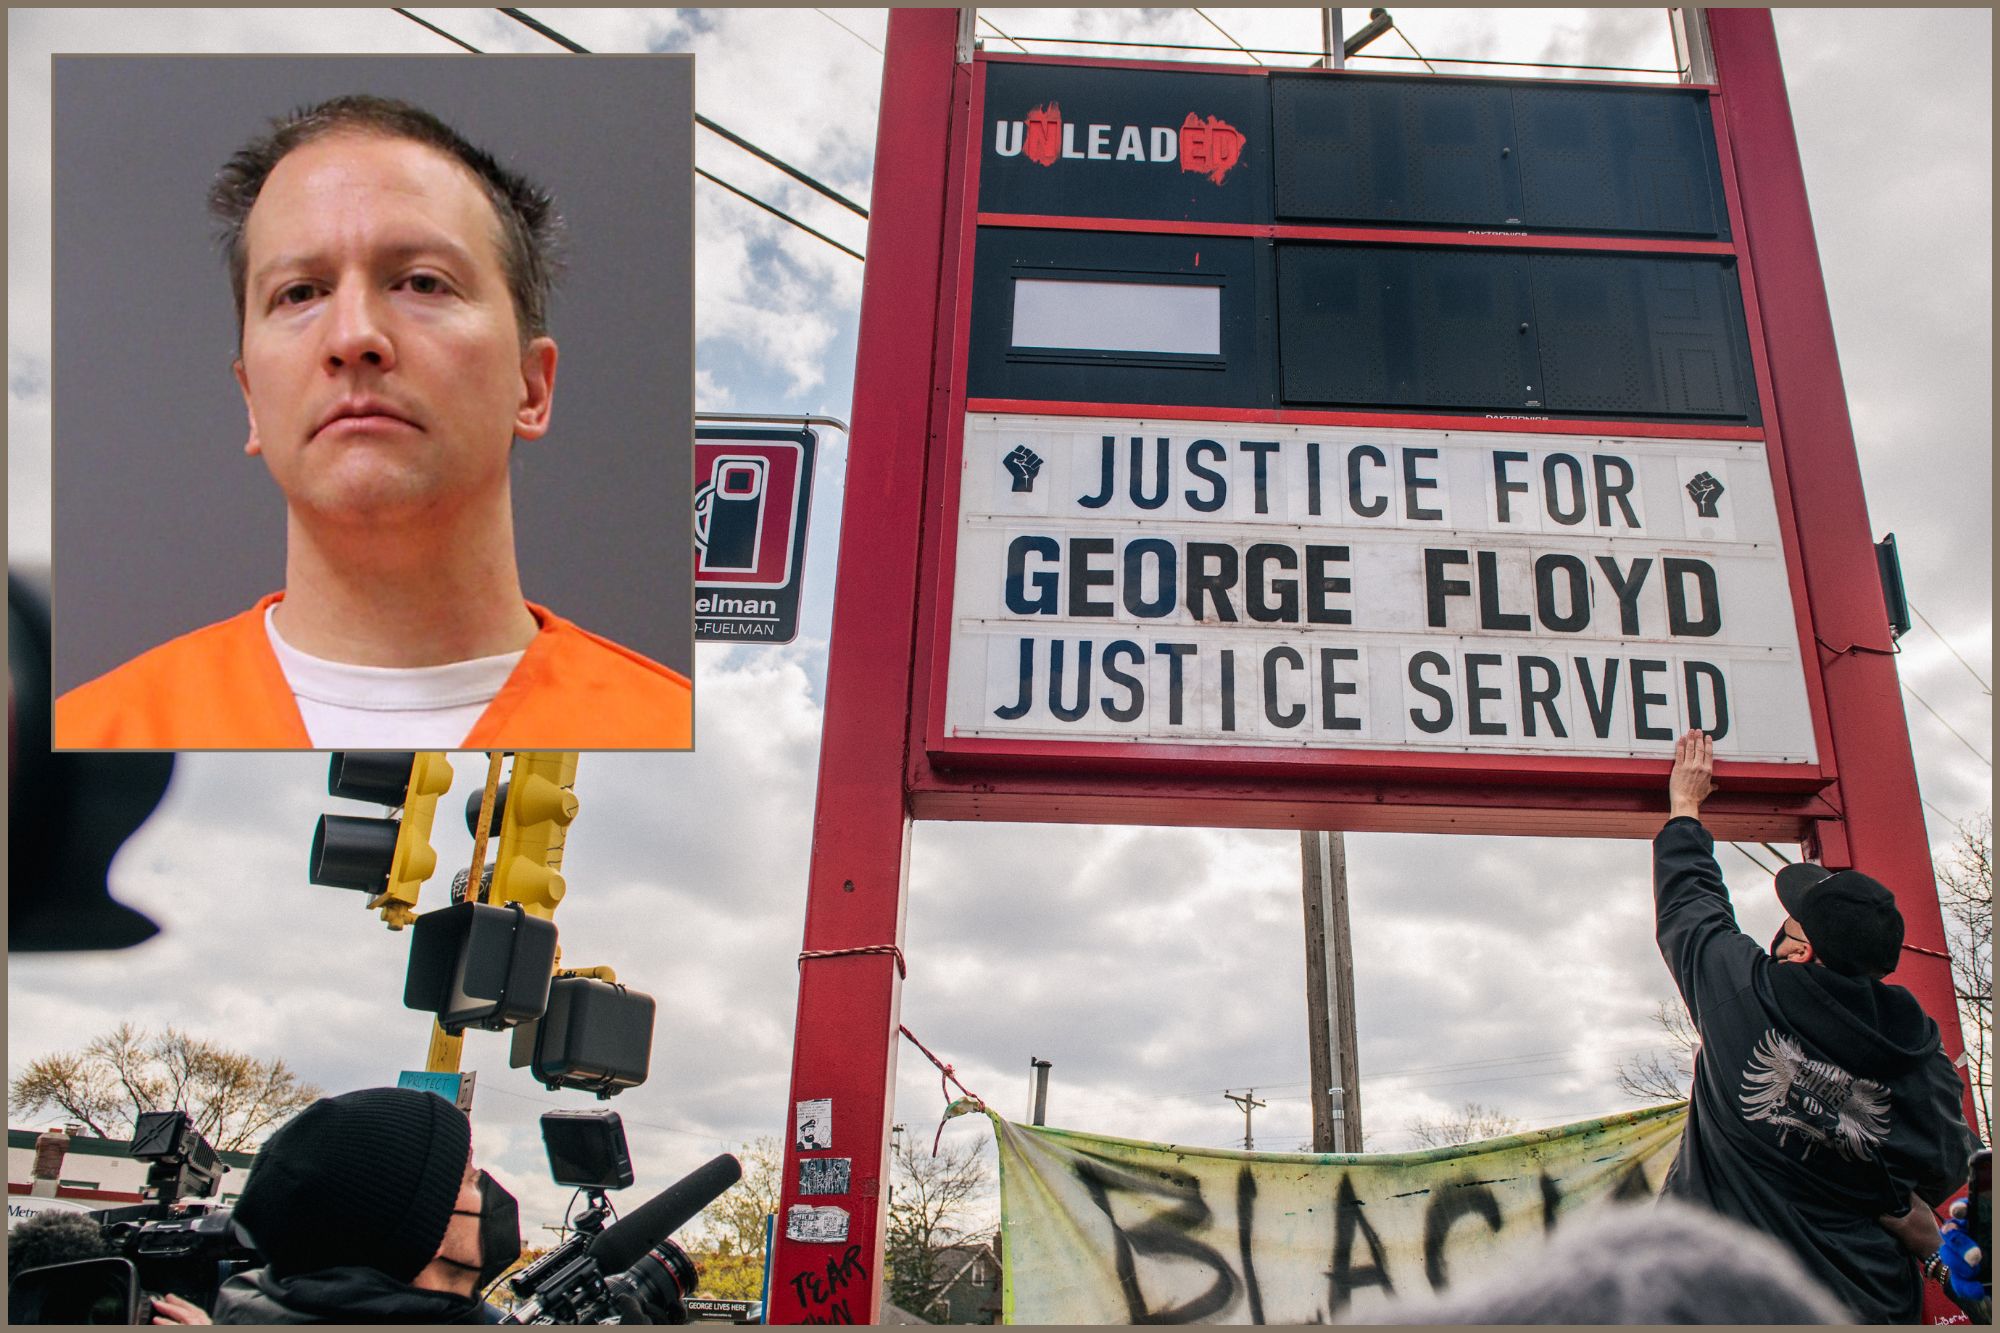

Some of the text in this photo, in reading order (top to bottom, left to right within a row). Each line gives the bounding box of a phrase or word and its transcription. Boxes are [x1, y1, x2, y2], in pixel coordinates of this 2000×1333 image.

[1077, 436, 1642, 529] JUSTICE FOR
[1005, 535, 1722, 638] GEORGE FLOYD
[993, 638, 1729, 742] JUSTICE SERVED
[407, 1074, 450, 1091] PROTECT
[688, 1302, 747, 1312] GEORGE LIVES HERE
[790, 1245, 867, 1309] TEAR
